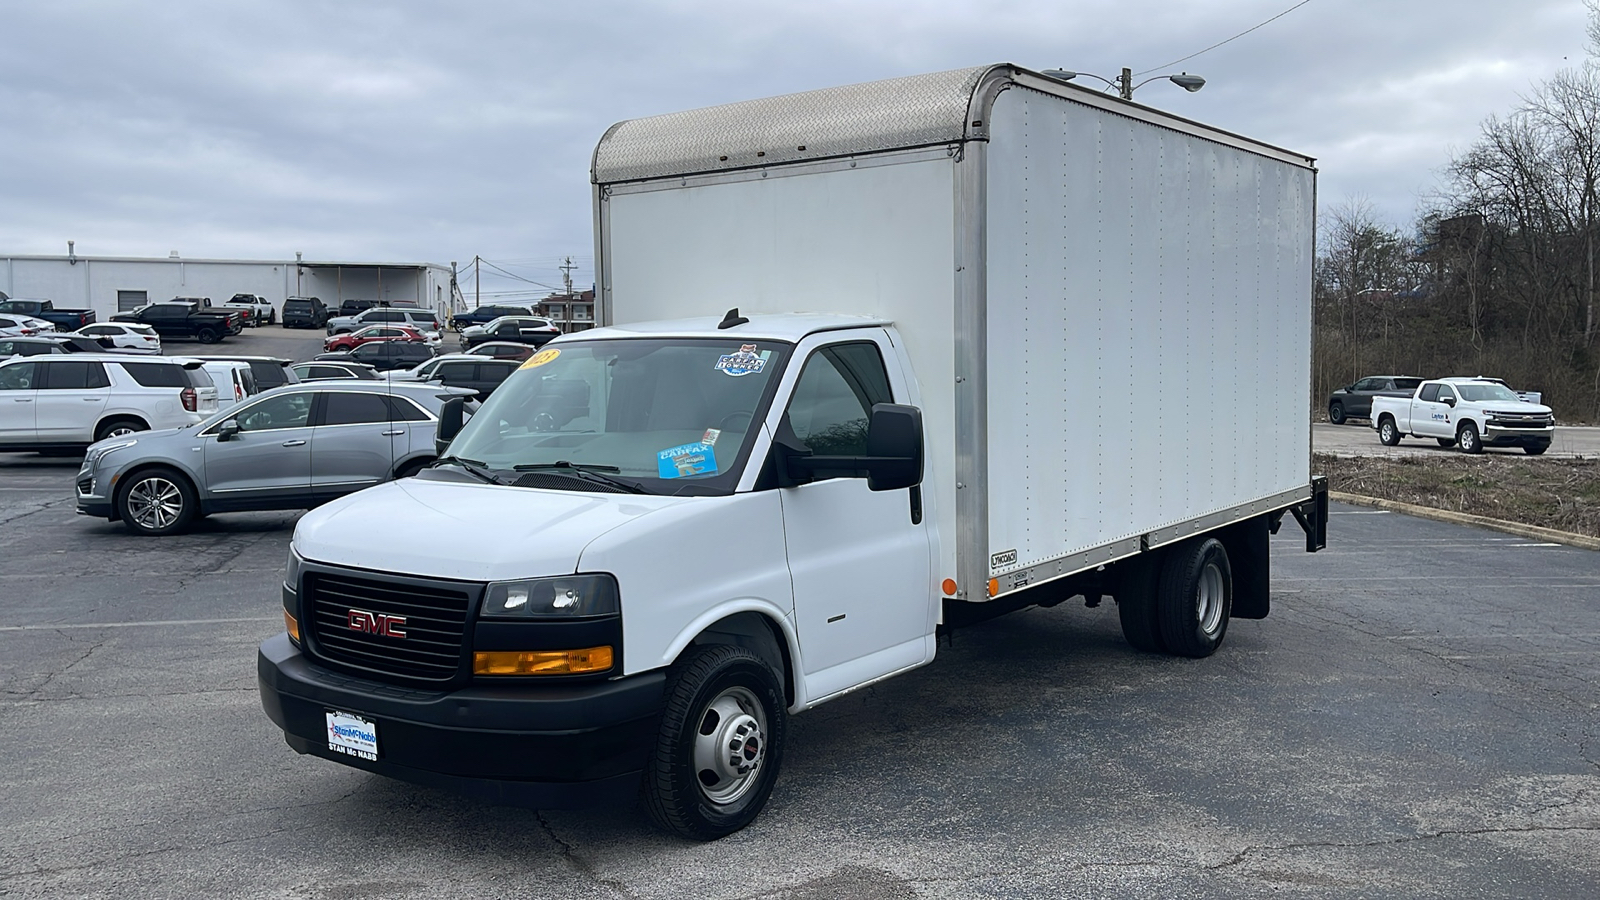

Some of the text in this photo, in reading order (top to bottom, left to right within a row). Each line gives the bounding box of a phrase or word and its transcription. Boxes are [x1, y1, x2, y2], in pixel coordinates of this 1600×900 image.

[660, 445, 709, 460] CARFAX
[347, 608, 407, 639] GMC
[328, 742, 346, 754] STAN
[357, 750, 377, 762] NABB
